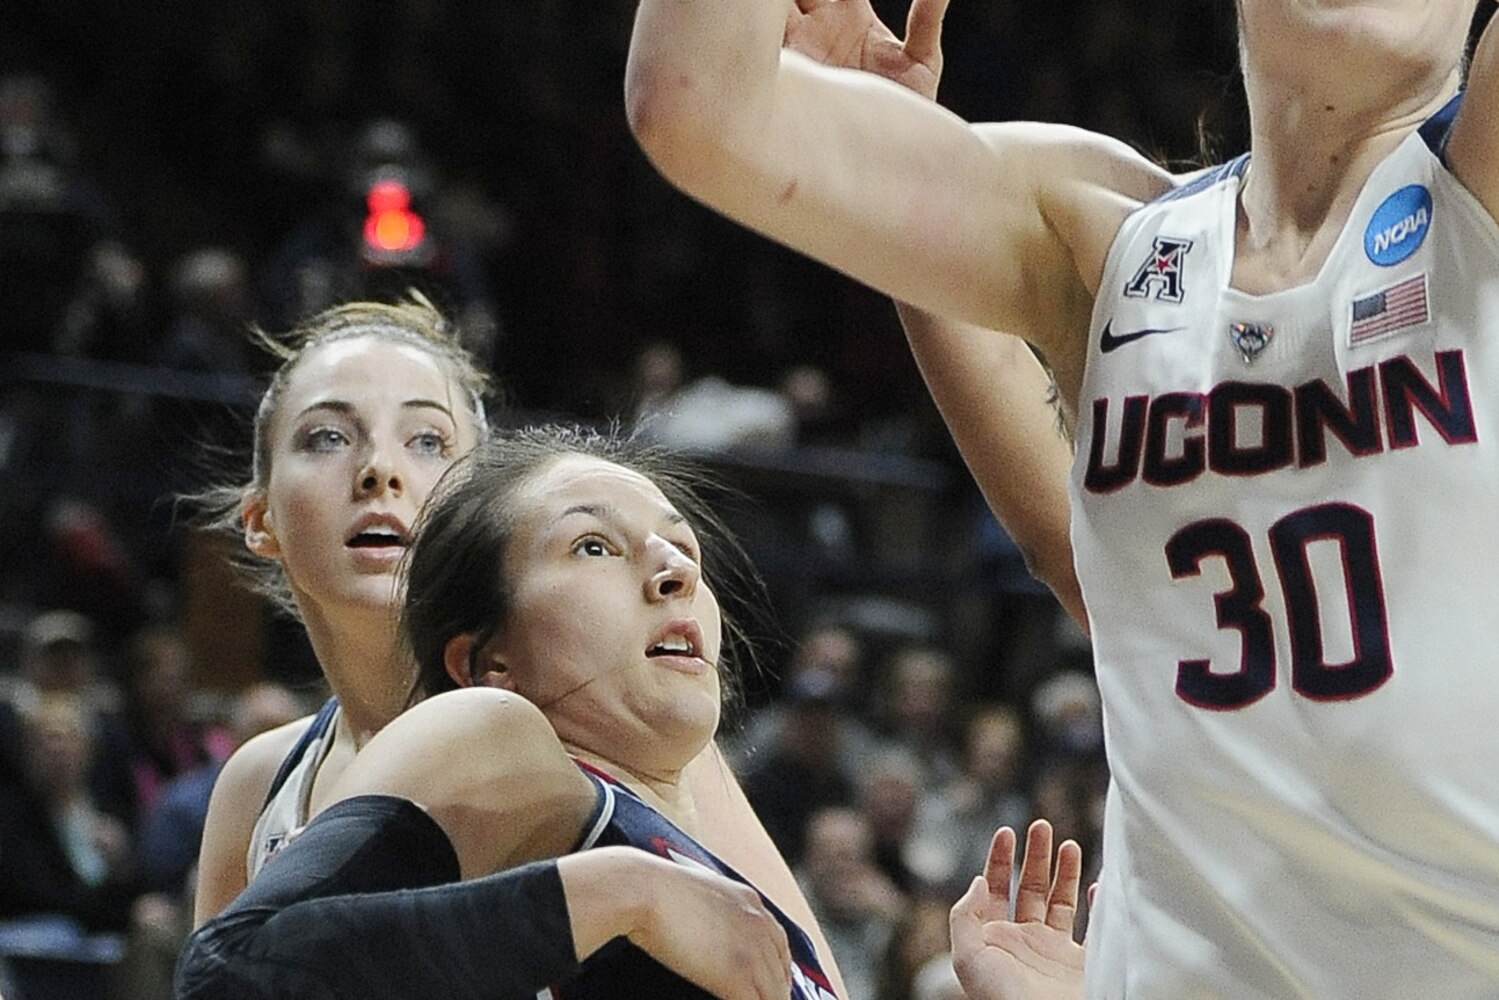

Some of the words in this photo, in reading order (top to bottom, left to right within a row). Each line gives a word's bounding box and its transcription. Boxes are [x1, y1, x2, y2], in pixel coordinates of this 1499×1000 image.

[1373, 206, 1428, 255] NCAA
[1084, 348, 1479, 494] UCONN
[1164, 501, 1395, 711] 30
